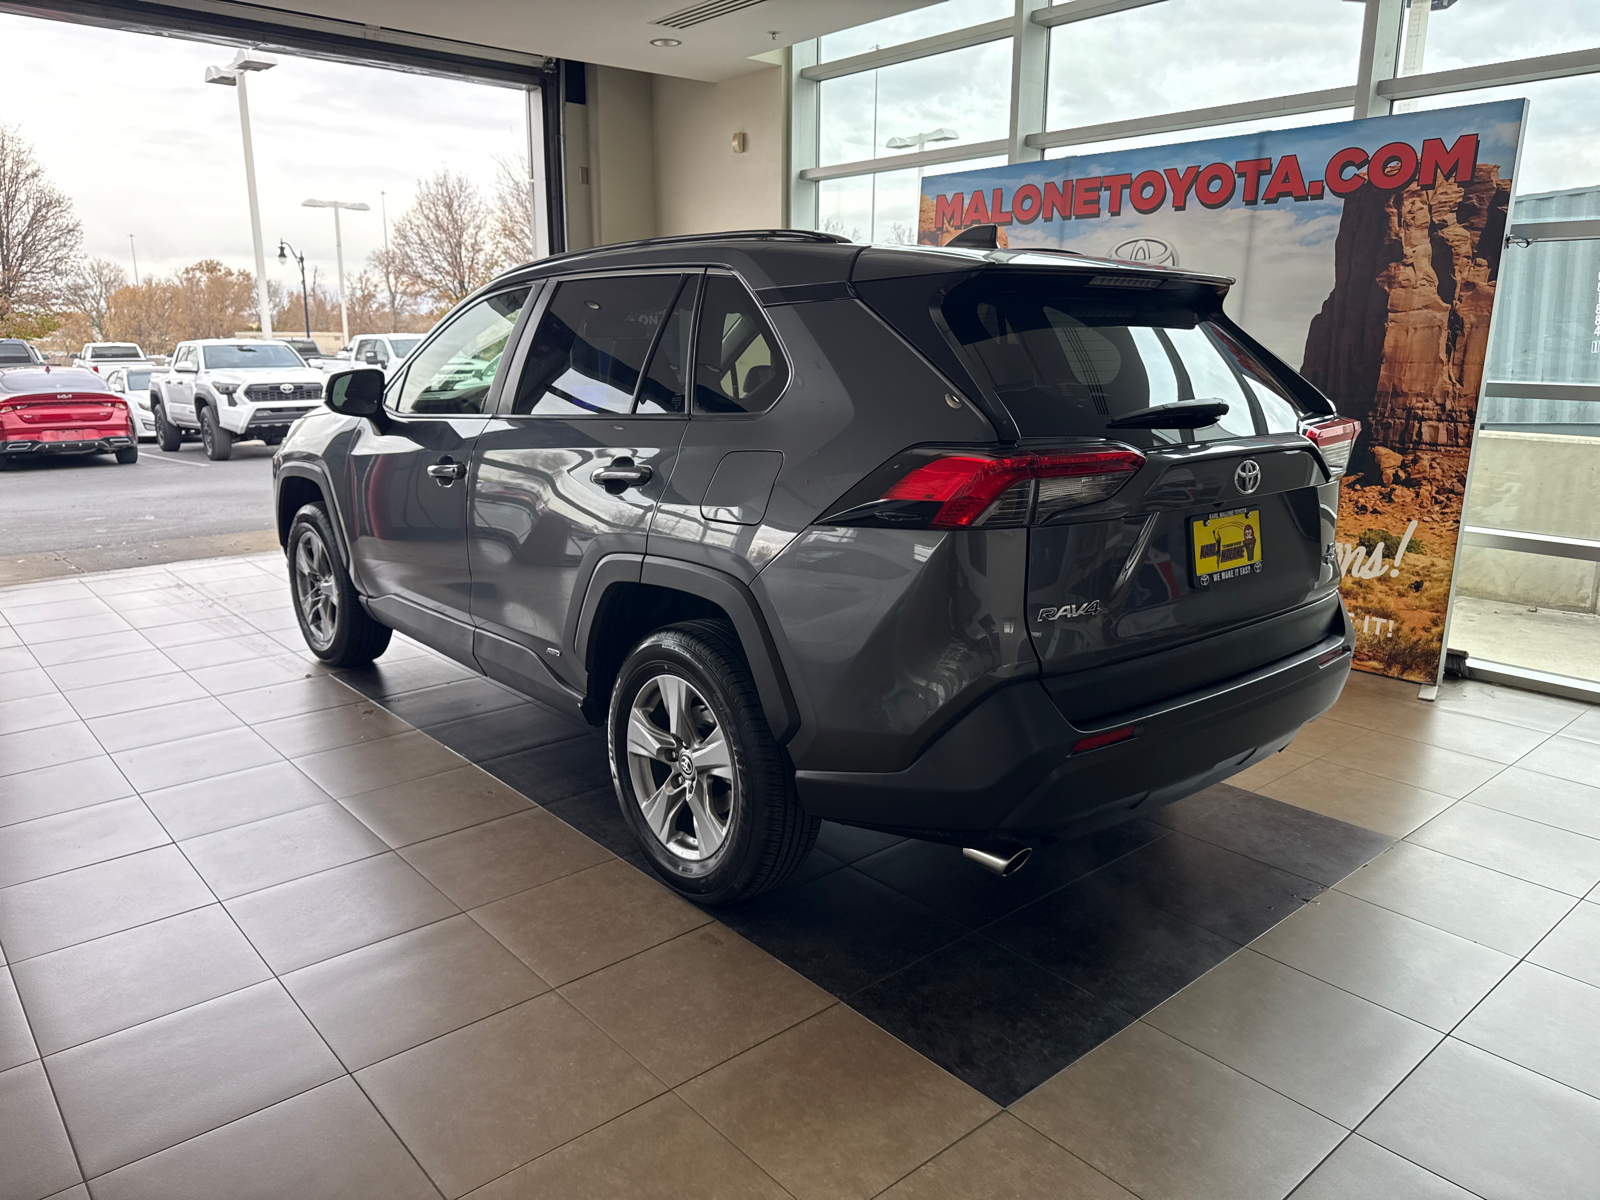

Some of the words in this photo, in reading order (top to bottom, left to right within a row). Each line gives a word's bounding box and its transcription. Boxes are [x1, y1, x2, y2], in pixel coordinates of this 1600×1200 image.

[935, 133, 1480, 230] MALONETOYOTA.COM
[1245, 529, 1253, 539] 32
[1213, 572, 1221, 582] WE
[1221, 569, 1234, 580] MAKE
[1234, 567, 1240, 577] IT
[1240, 565, 1251, 575] EASY
[1037, 599, 1101, 623] RAV4
[1363, 615, 1395, 638] IT!
